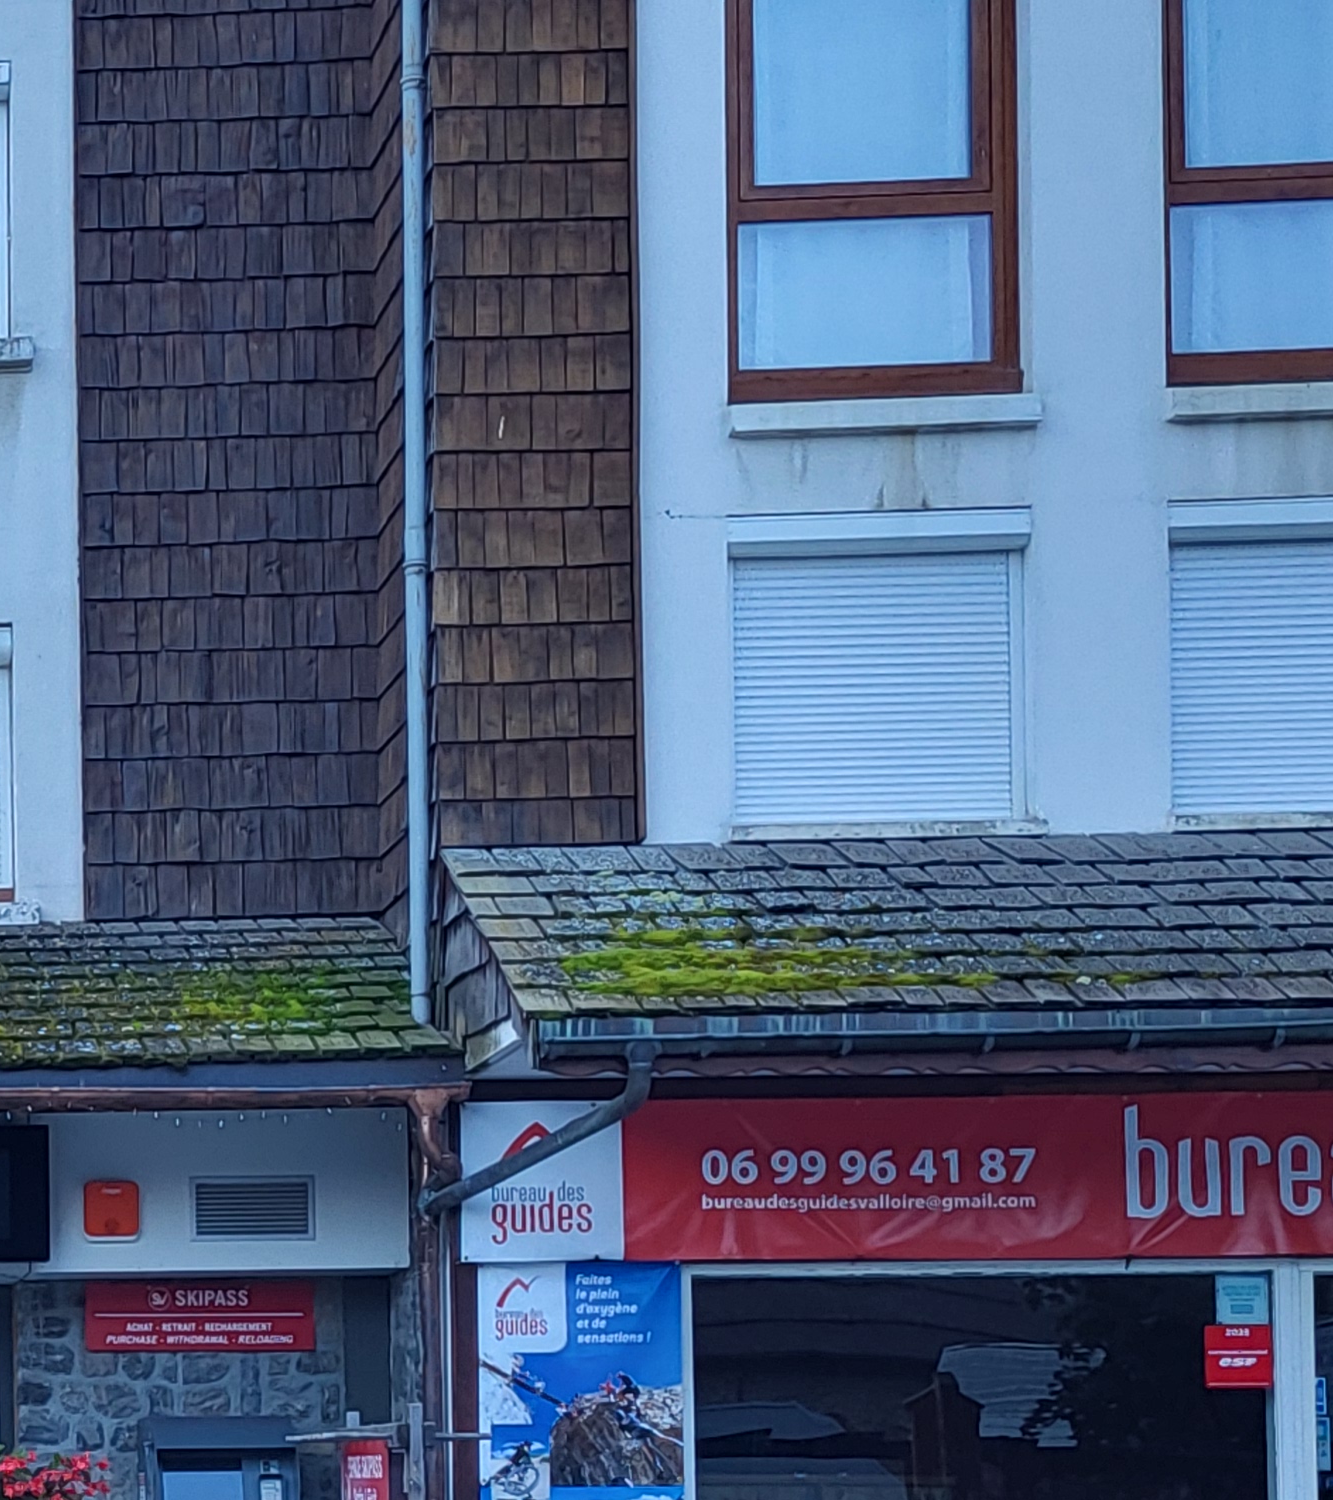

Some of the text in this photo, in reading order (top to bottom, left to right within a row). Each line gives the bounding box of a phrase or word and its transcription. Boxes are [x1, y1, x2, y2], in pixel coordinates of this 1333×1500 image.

[701, 1148, 1036, 1185] 06 99 96 41 87
[1124, 1104, 1333, 1219] bure
[491, 1180, 585, 1202] bureau des
[701, 1193, 1037, 1213] bureaudesguidesvalloire@gmail.com
[491, 1191, 593, 1244] guides
[575, 1274, 612, 1286] Faites
[175, 1289, 249, 1307] SKIPASS
[589, 1288, 620, 1302] plein
[161, 1323, 196, 1331] RETRAIT
[495, 1313, 549, 1341] guides
[591, 1318, 608, 1329] de
[106, 1335, 158, 1344] PURCHASE
